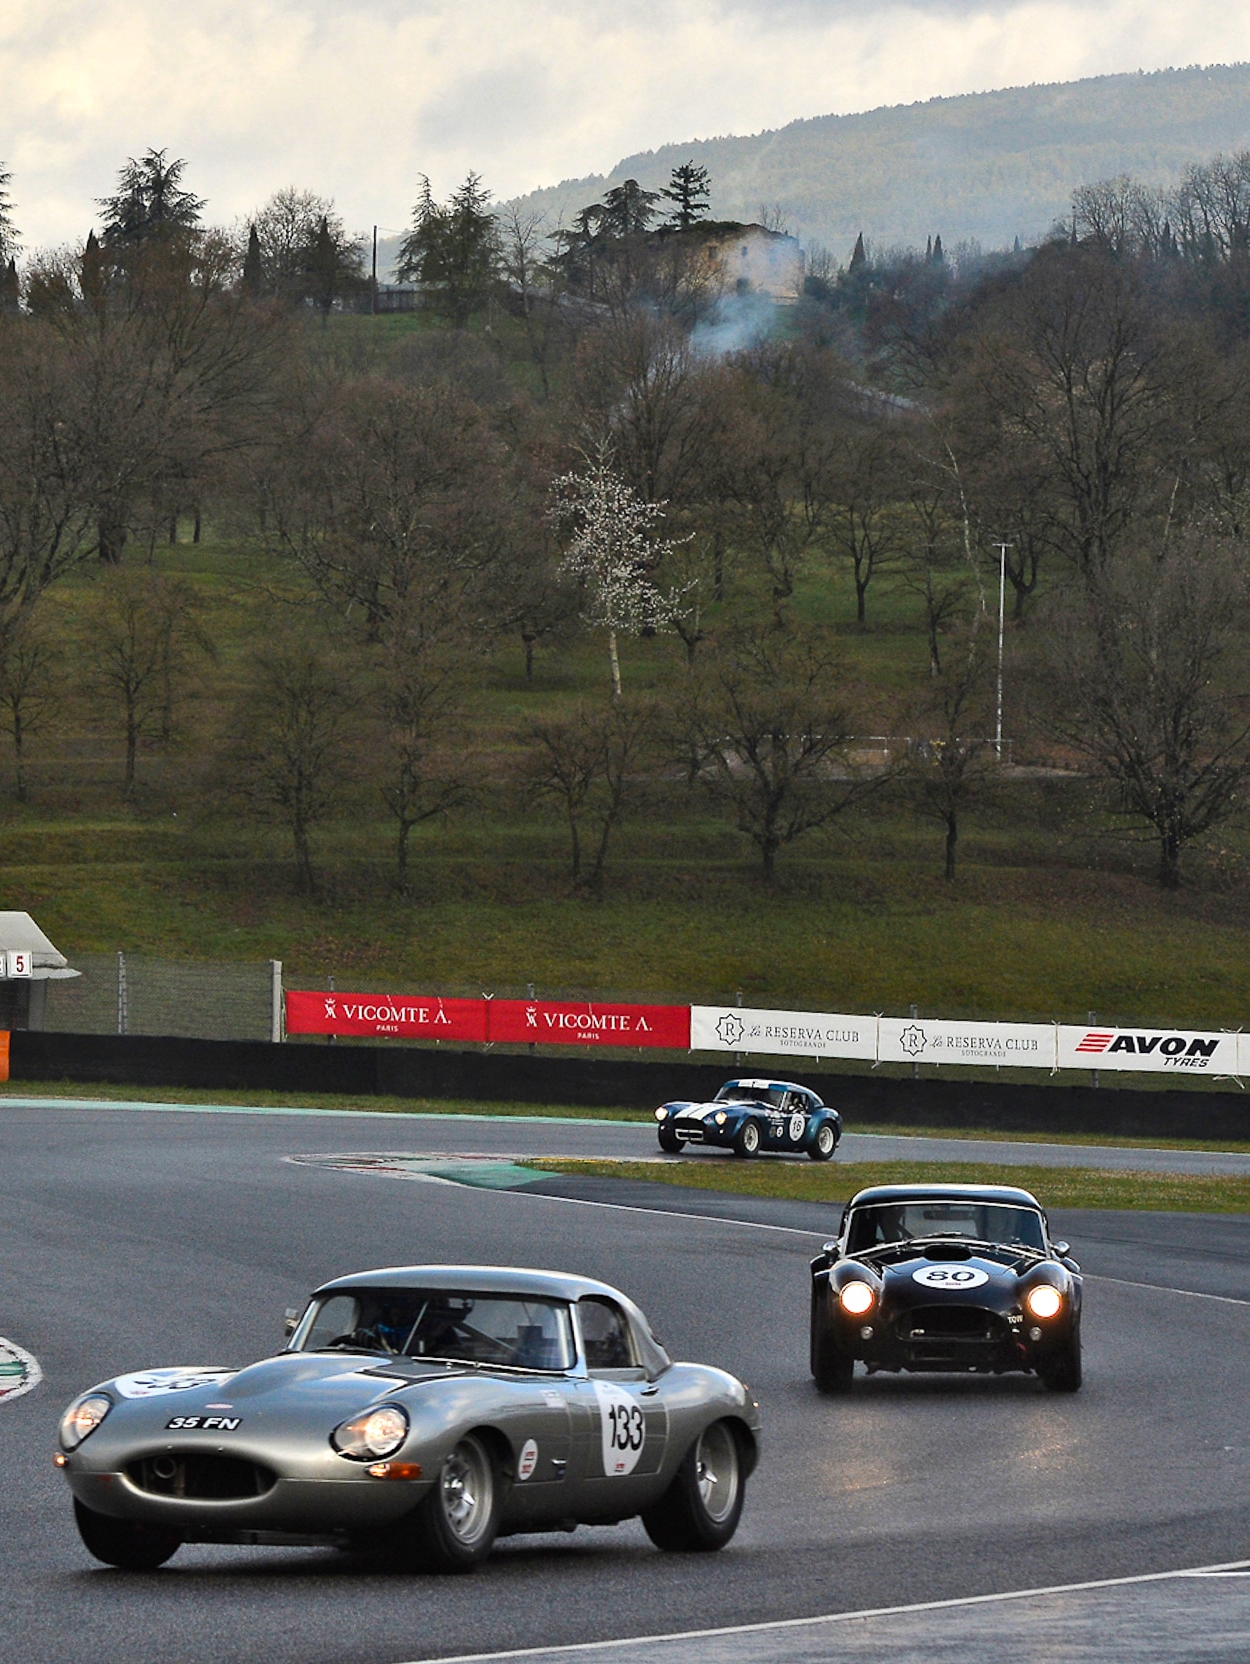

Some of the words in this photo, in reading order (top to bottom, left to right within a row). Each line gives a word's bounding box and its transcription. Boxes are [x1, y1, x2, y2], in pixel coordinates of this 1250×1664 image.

[16, 955, 25, 973] 5
[342, 1003, 429, 1024] VICOMTE
[434, 1008, 452, 1025] A.
[376, 1024, 399, 1032] PARIS
[543, 1012, 630, 1031] VICOMTE
[635, 1016, 653, 1031] A.
[577, 1032, 600, 1040] PARIS
[725, 1022, 735, 1036] R
[765, 1026, 822, 1040] RESERVA
[825, 1030, 859, 1043] CLUB
[780, 1040, 826, 1048] SOTOGRANDE
[909, 1033, 918, 1047] R
[947, 1036, 1002, 1050] RESERVA
[1005, 1039, 1039, 1051] CLUB
[1107, 1035, 1220, 1058] AVON
[961, 1049, 1006, 1058] SOTOGRANDE
[1163, 1057, 1210, 1068] TYRES
[926, 1270, 975, 1282] 80
[168, 1416, 201, 1429] 35
[202, 1417, 240, 1430] FN
[608, 1403, 643, 1451] 133
